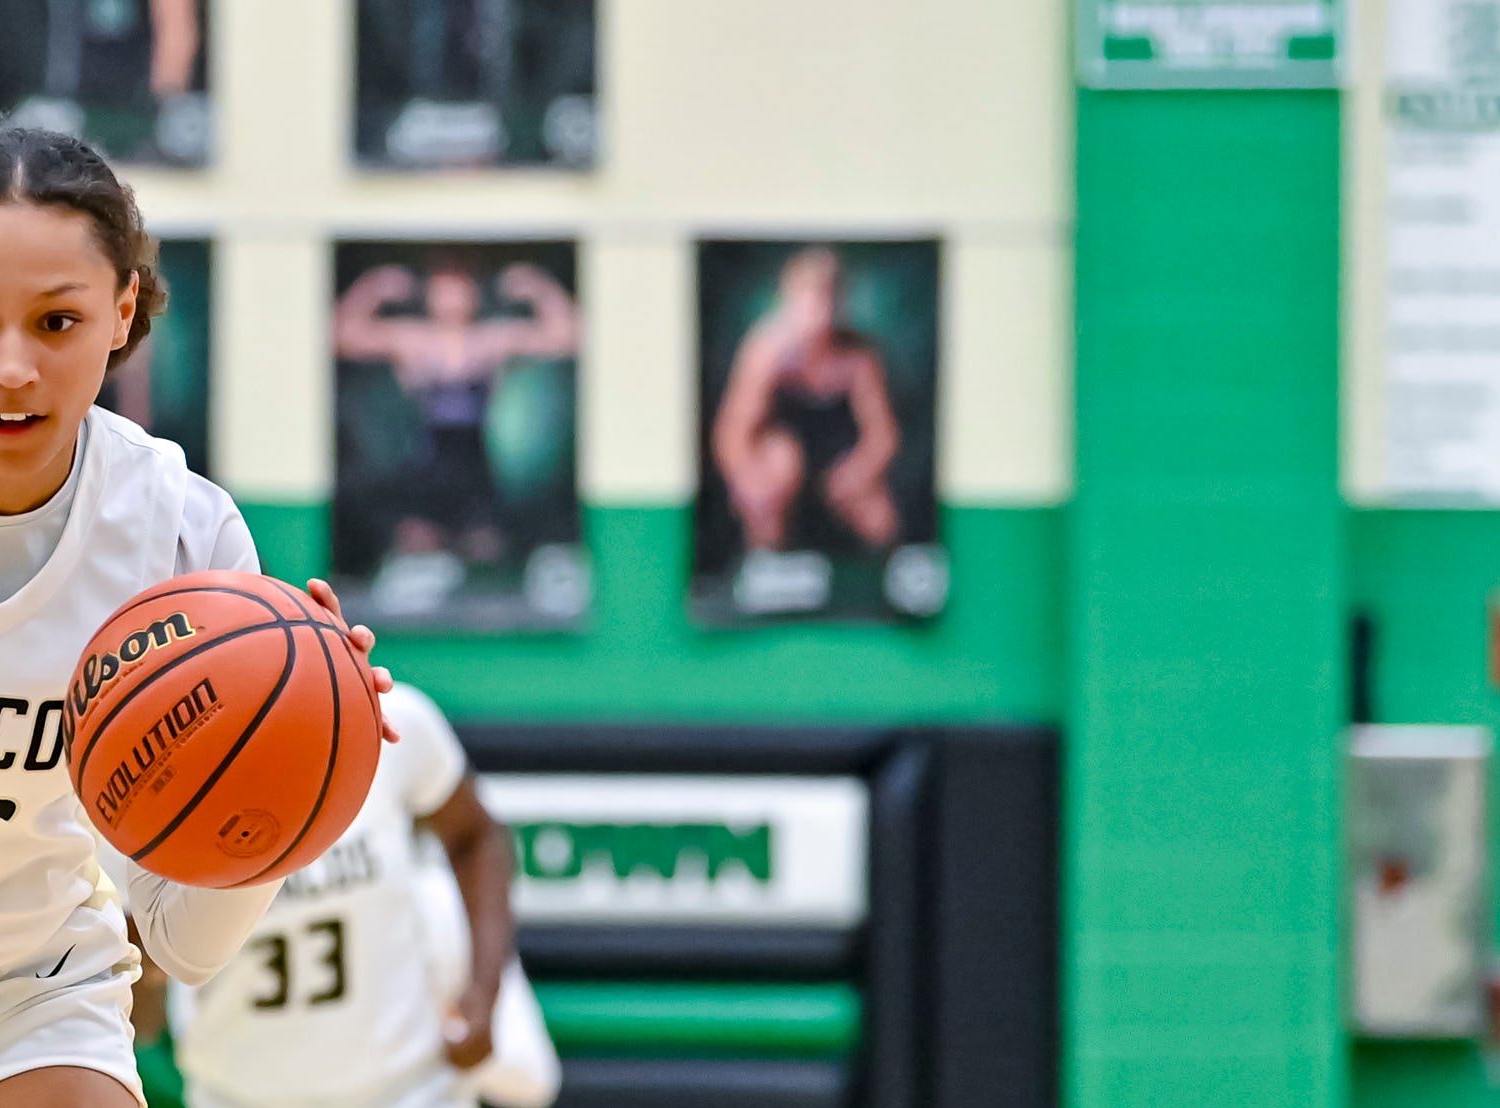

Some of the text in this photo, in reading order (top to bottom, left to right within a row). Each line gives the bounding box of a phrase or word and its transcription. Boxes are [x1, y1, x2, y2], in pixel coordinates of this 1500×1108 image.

[96, 677, 218, 824] EVOLUTION
[508, 823, 771, 880] OWN
[252, 918, 346, 1008] 33
